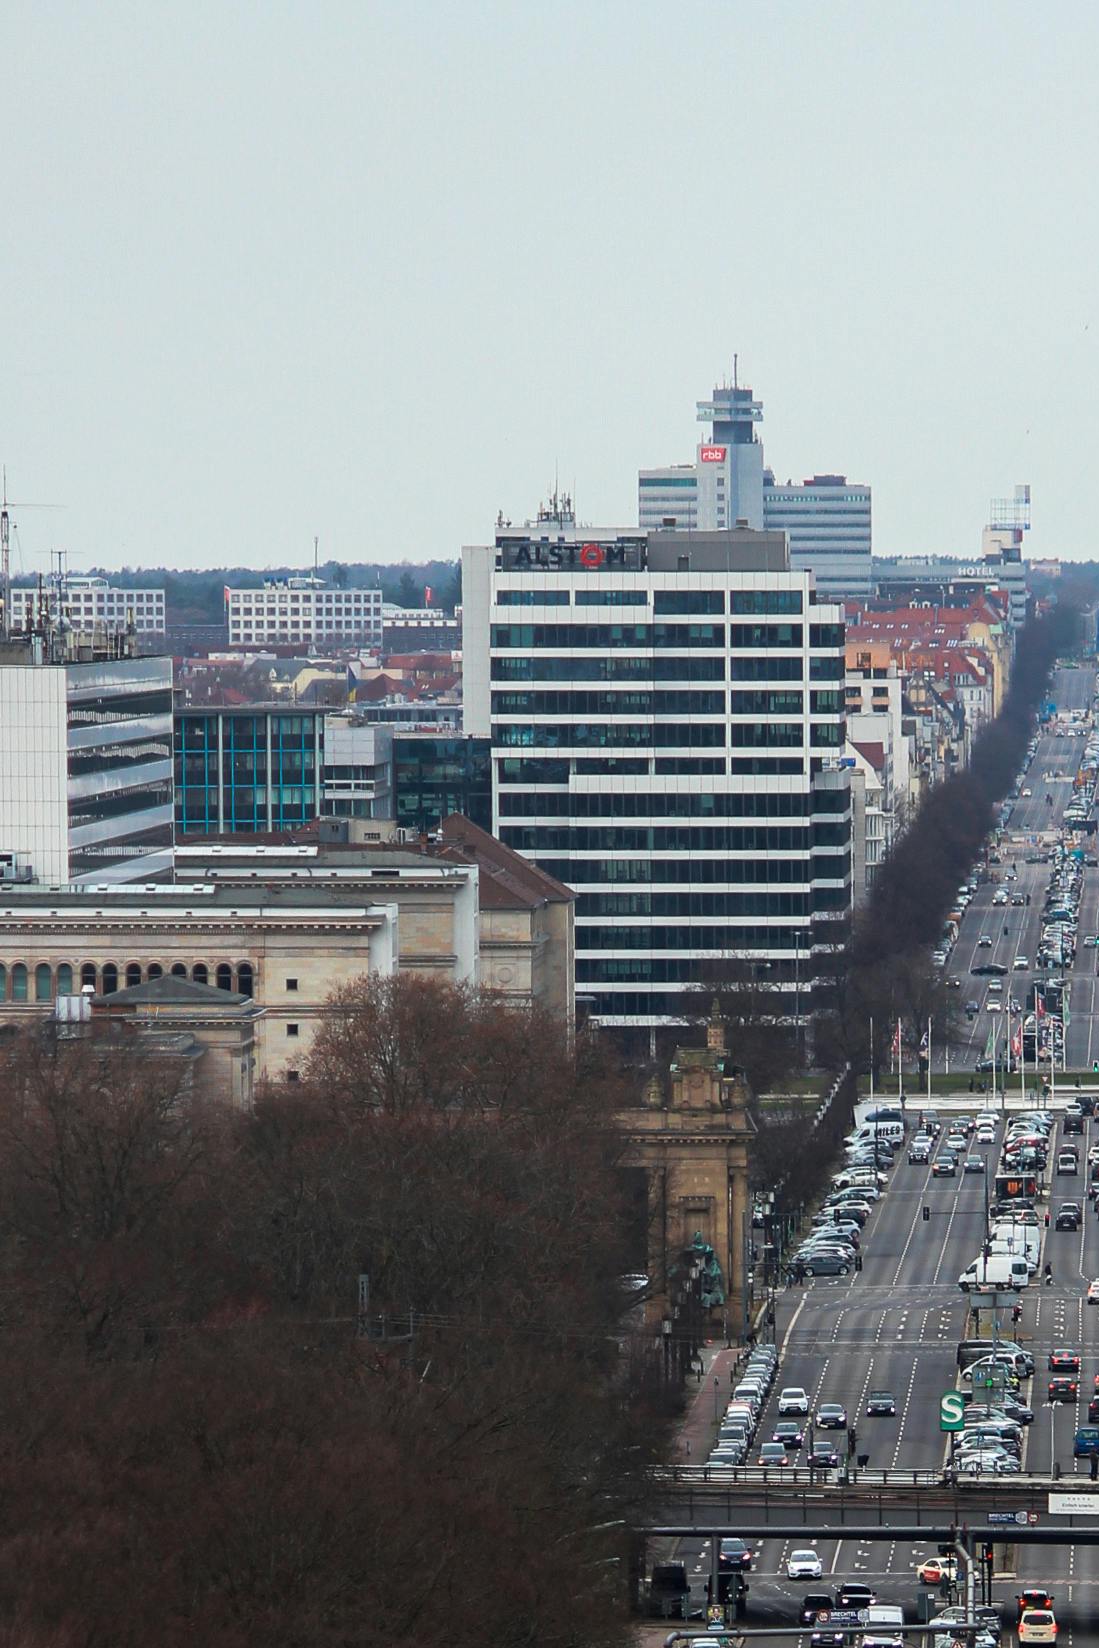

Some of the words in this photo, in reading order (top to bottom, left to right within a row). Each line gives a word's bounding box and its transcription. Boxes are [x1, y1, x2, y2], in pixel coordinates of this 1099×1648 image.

[702, 449, 722, 460] rbb
[514, 543, 626, 566] ALSTOM
[958, 567, 994, 576] HOTEL
[941, 1395, 963, 1423] S
